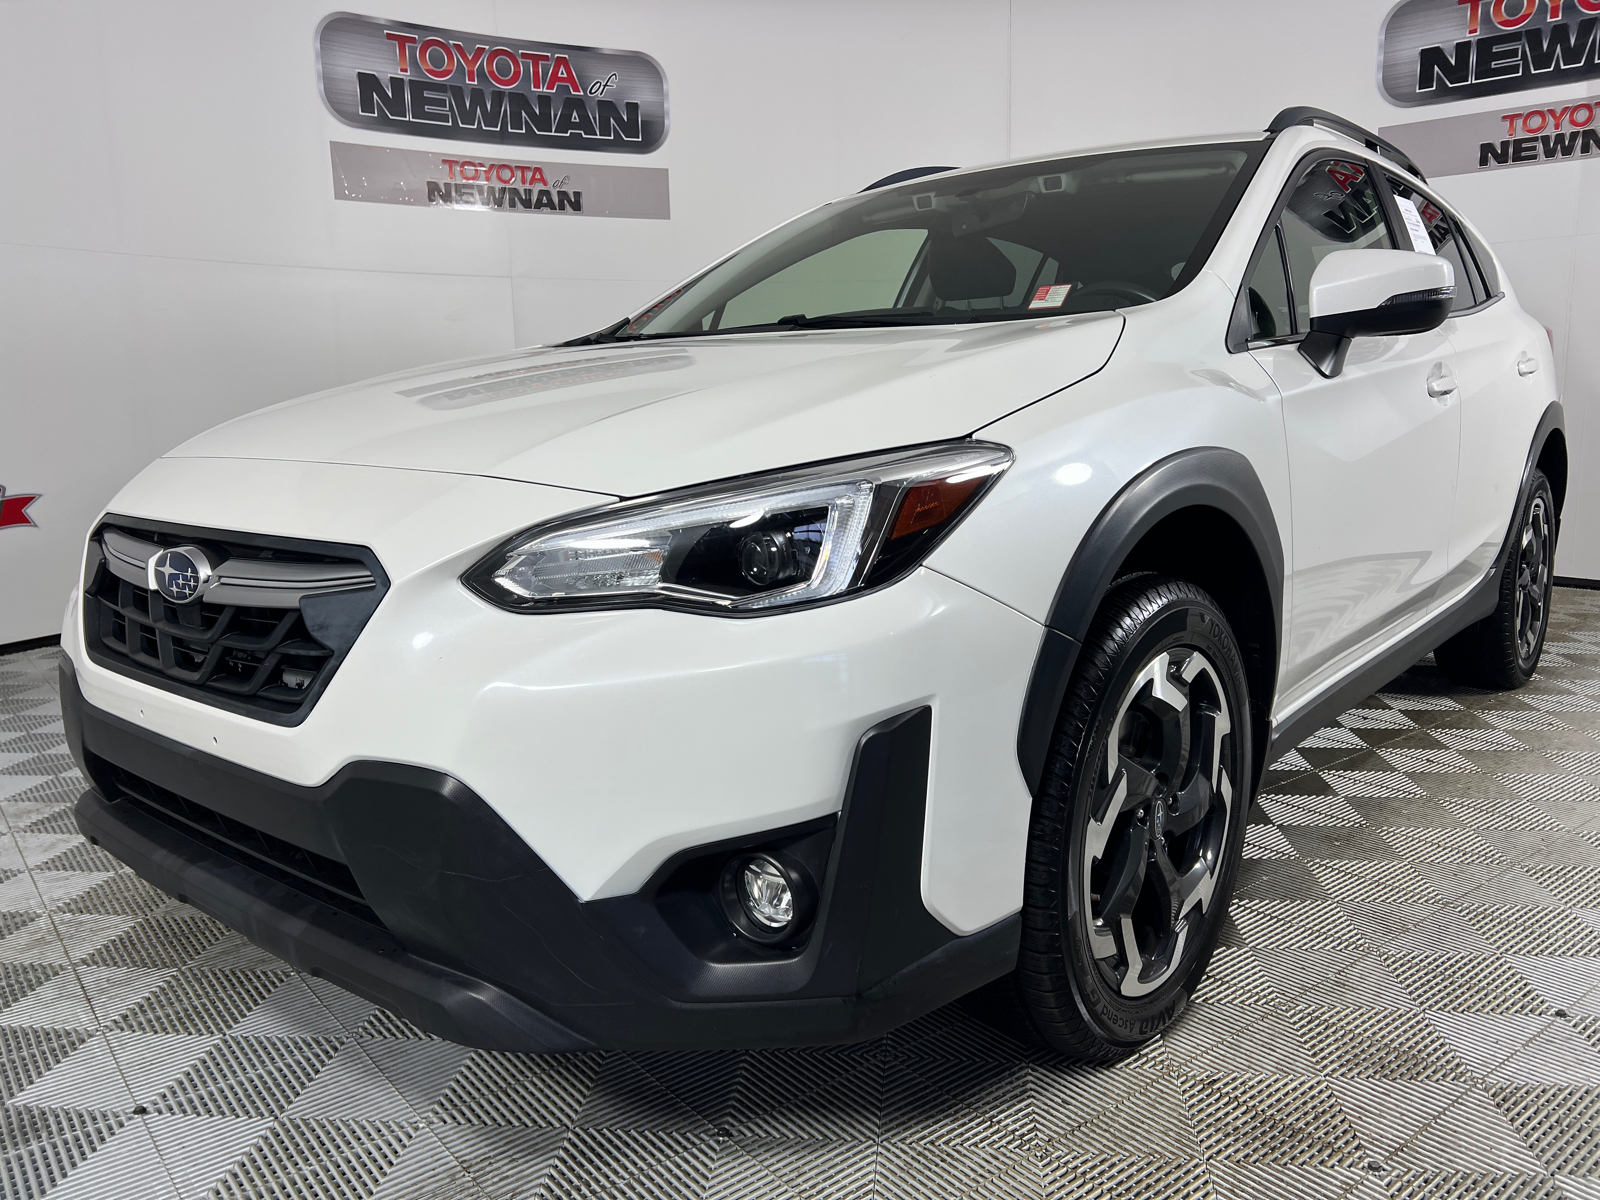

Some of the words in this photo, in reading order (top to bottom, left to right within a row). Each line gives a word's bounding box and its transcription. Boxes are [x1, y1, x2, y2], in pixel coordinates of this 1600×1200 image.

[384, 30, 584, 95] TOYOTA
[587, 72, 618, 97] of
[1416, 16, 1600, 93] NEW
[356, 71, 642, 141] NEWNAN
[1501, 100, 1600, 137] TOYO
[441, 158, 549, 187] TOYOTA
[552, 174, 571, 189] of
[426, 180, 583, 213] NEWNAN
[1100, 1003, 1135, 1034] Ascend
